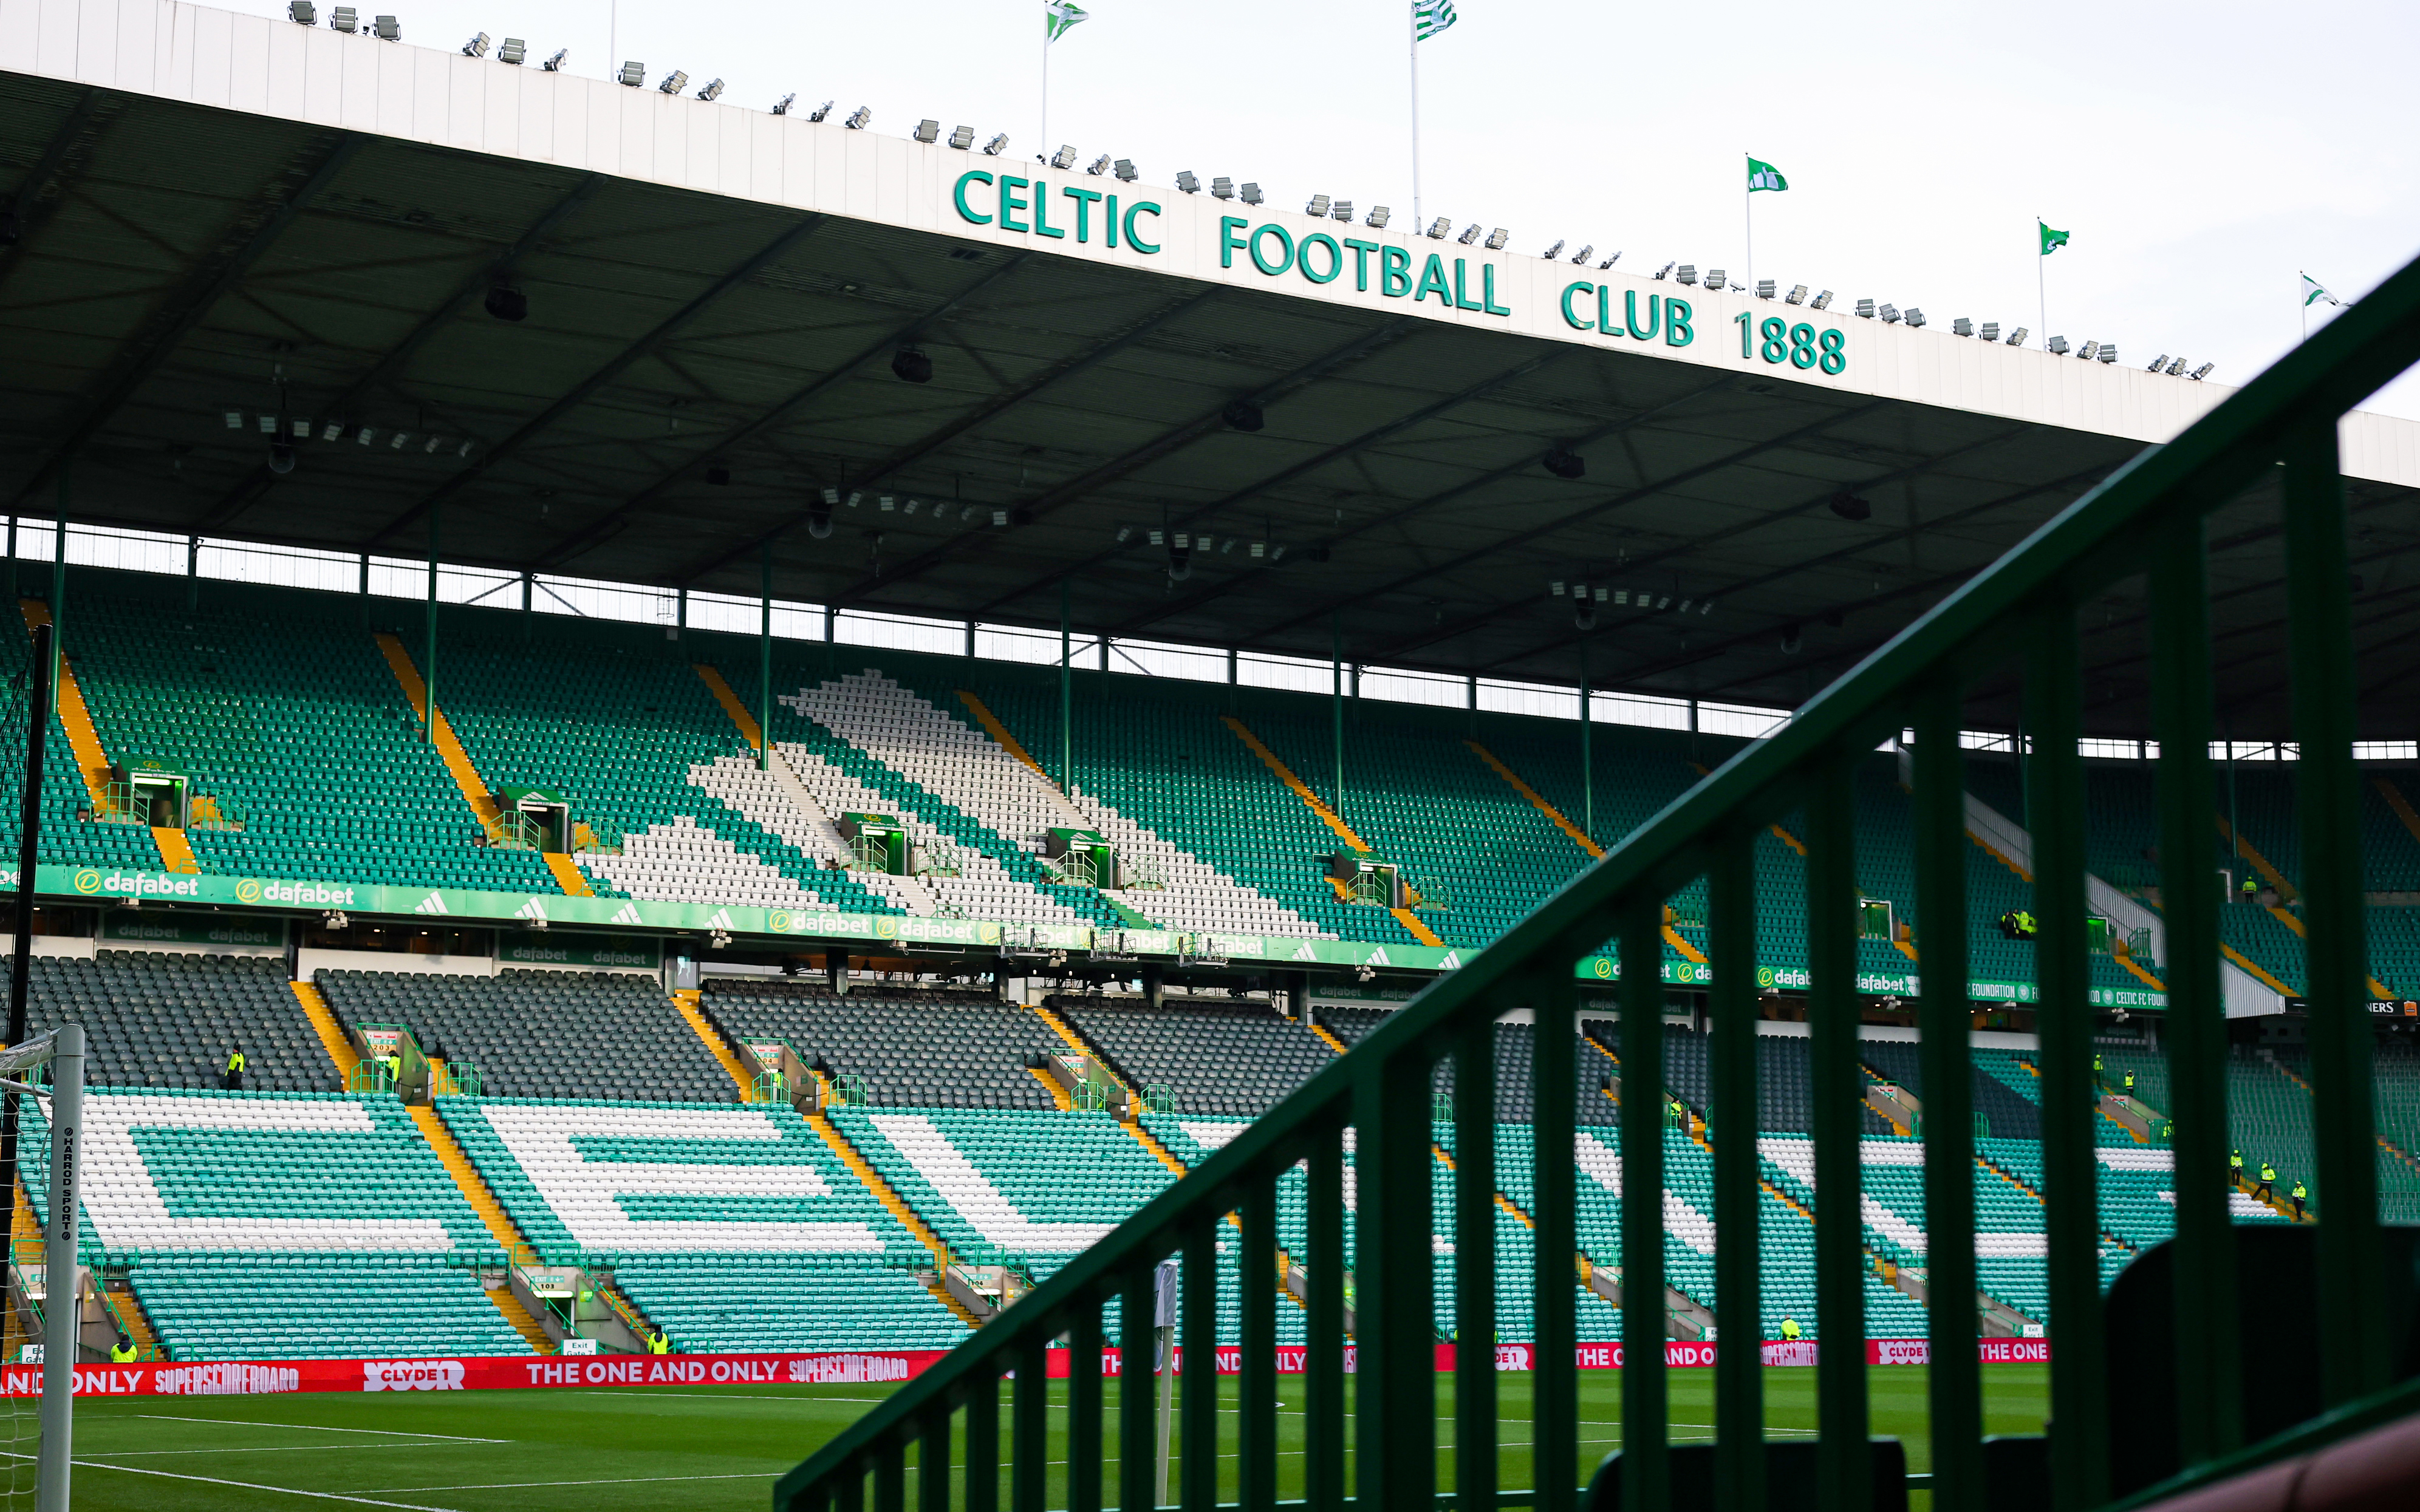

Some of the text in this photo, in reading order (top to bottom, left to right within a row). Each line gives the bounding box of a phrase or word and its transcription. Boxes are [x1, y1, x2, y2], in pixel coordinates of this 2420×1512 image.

[954, 171, 1846, 375] CELTIC FOOTBALL CLUB 1888
[104, 870, 198, 896] dafabet
[264, 881, 354, 905] dafabet
[118, 922, 180, 941] dafabet
[793, 912, 869, 934] dafabet
[900, 919, 972, 939] dafabet
[208, 927, 268, 944] dafabet
[513, 945, 567, 962] dafabet
[593, 950, 646, 965] dafabet
[1319, 986, 1361, 997] dafabet
[1972, 983, 2015, 998] FOUNDATION
[2116, 992, 2137, 1004] CELTIC
[2138, 993, 2146, 1005] FC
[61, 1138, 73, 1230] HARROD SPORT
[1888, 1347, 1923, 1357] CLYDE
[1978, 1343, 2048, 1360] THE ONE
[527, 1355, 908, 1384] THE ONE AND ONLY SUPERSCOREBOARD
[1215, 1353, 1242, 1371] ND
[1274, 1352, 1306, 1371] NLY
[156, 1364, 299, 1395] SUPERSCOREBOARD
[380, 1368, 449, 1382] CLYDE 1
